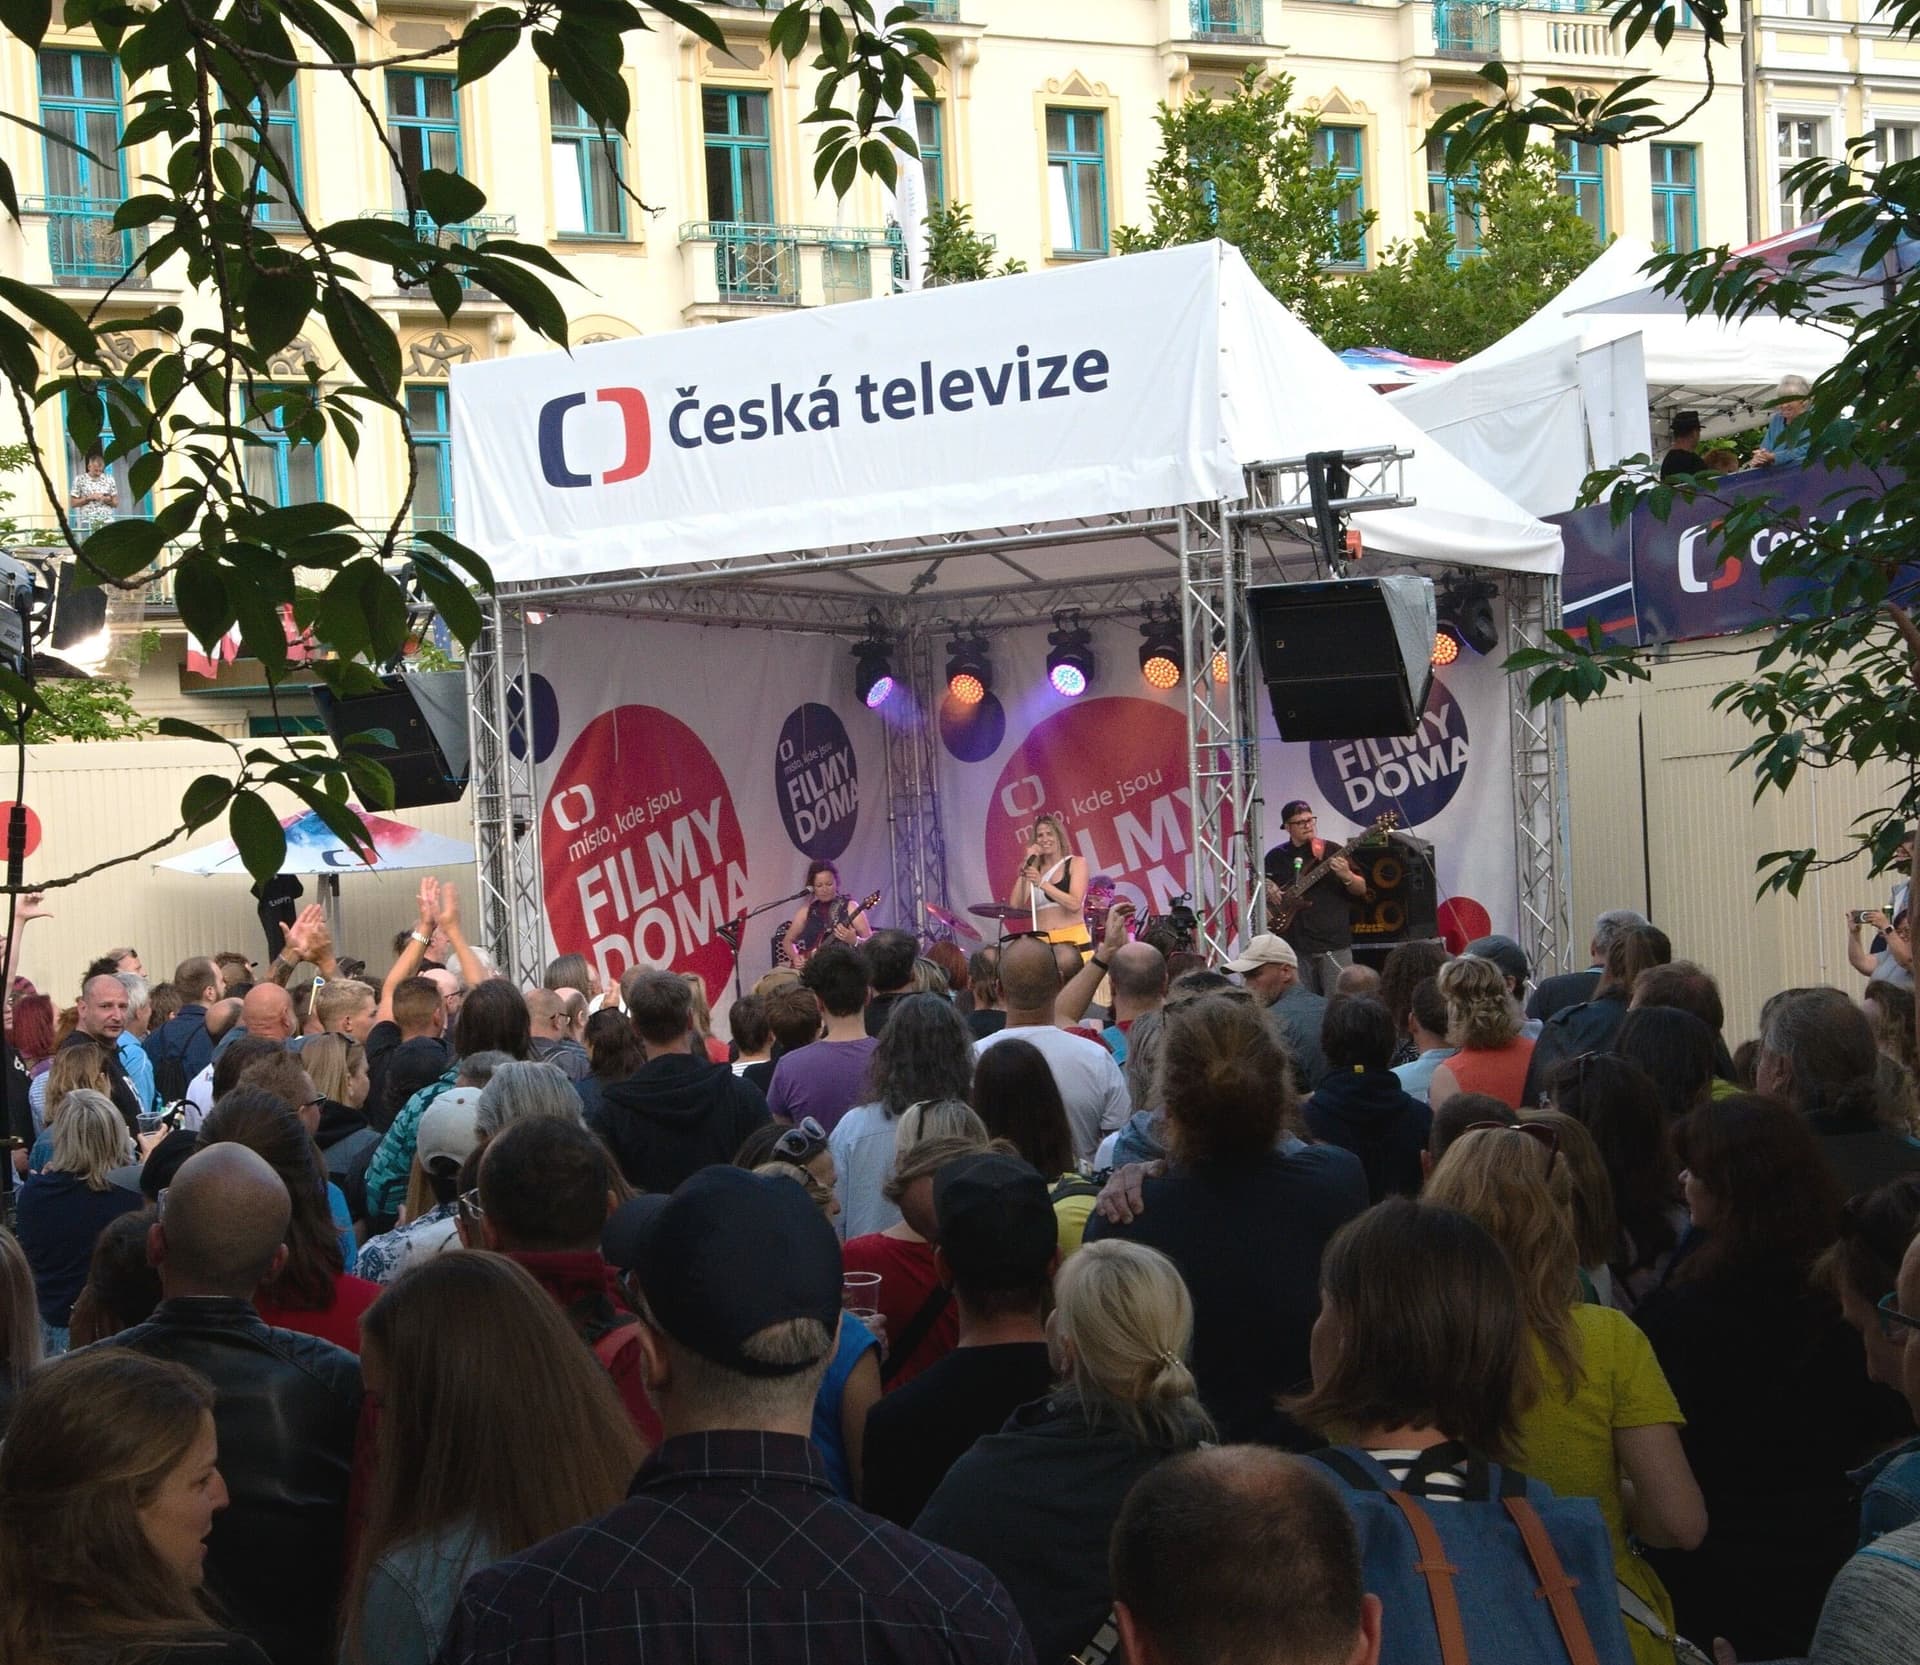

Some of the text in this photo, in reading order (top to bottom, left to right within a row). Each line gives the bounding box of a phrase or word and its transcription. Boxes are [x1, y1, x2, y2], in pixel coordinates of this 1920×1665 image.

[669, 344, 1109, 449] Česká televize
[787, 747, 849, 811] FILMY
[794, 777, 859, 843] DOMA
[1072, 790, 1113, 817] kde
[1117, 769, 1163, 804] jsou
[1343, 735, 1471, 813] DOMA
[568, 787, 682, 862] místo, kde jsou
[576, 796, 723, 940] FILMY
[592, 860, 750, 992] DOMA
